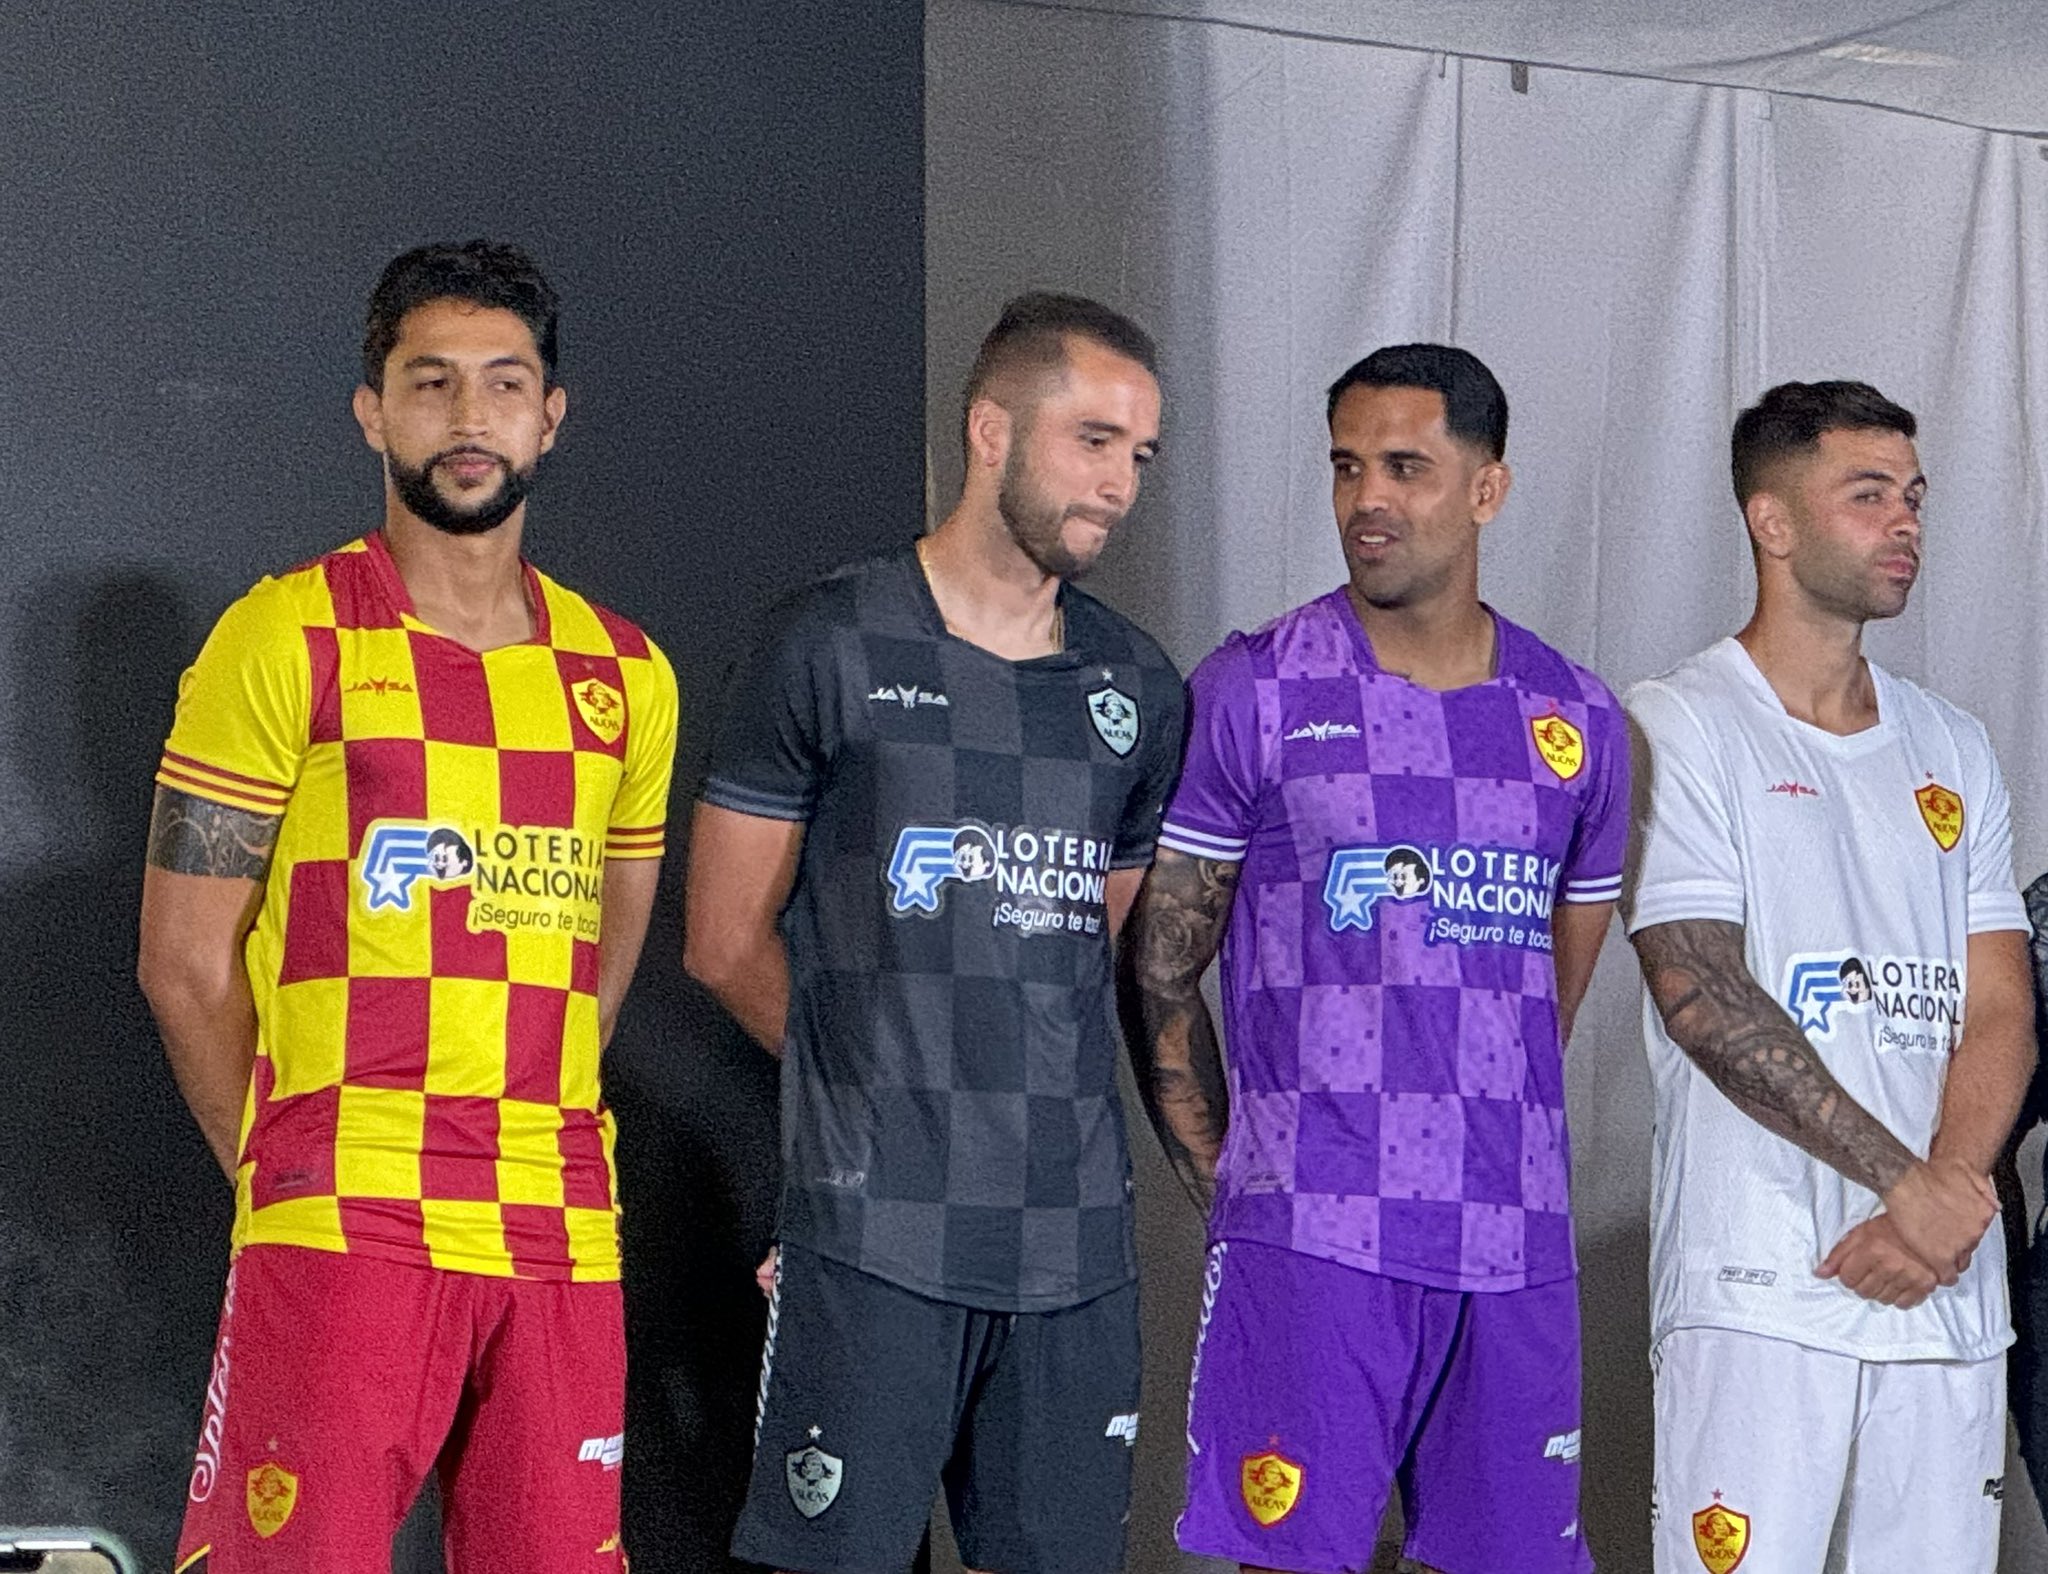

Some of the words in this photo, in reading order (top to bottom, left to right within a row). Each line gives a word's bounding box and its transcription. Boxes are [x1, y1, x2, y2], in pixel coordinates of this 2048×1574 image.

[476, 862, 601, 905] NACIONA
[996, 862, 1107, 905] NACIONA
[1433, 879, 1553, 920] NACIONA
[473, 902, 552, 930] ¡Seguro
[558, 910, 574, 931] te
[993, 902, 1065, 931] ¡Seguro
[1067, 911, 1083, 932] te
[1429, 917, 1505, 946] ¡Seguro
[1508, 925, 1525, 946] te
